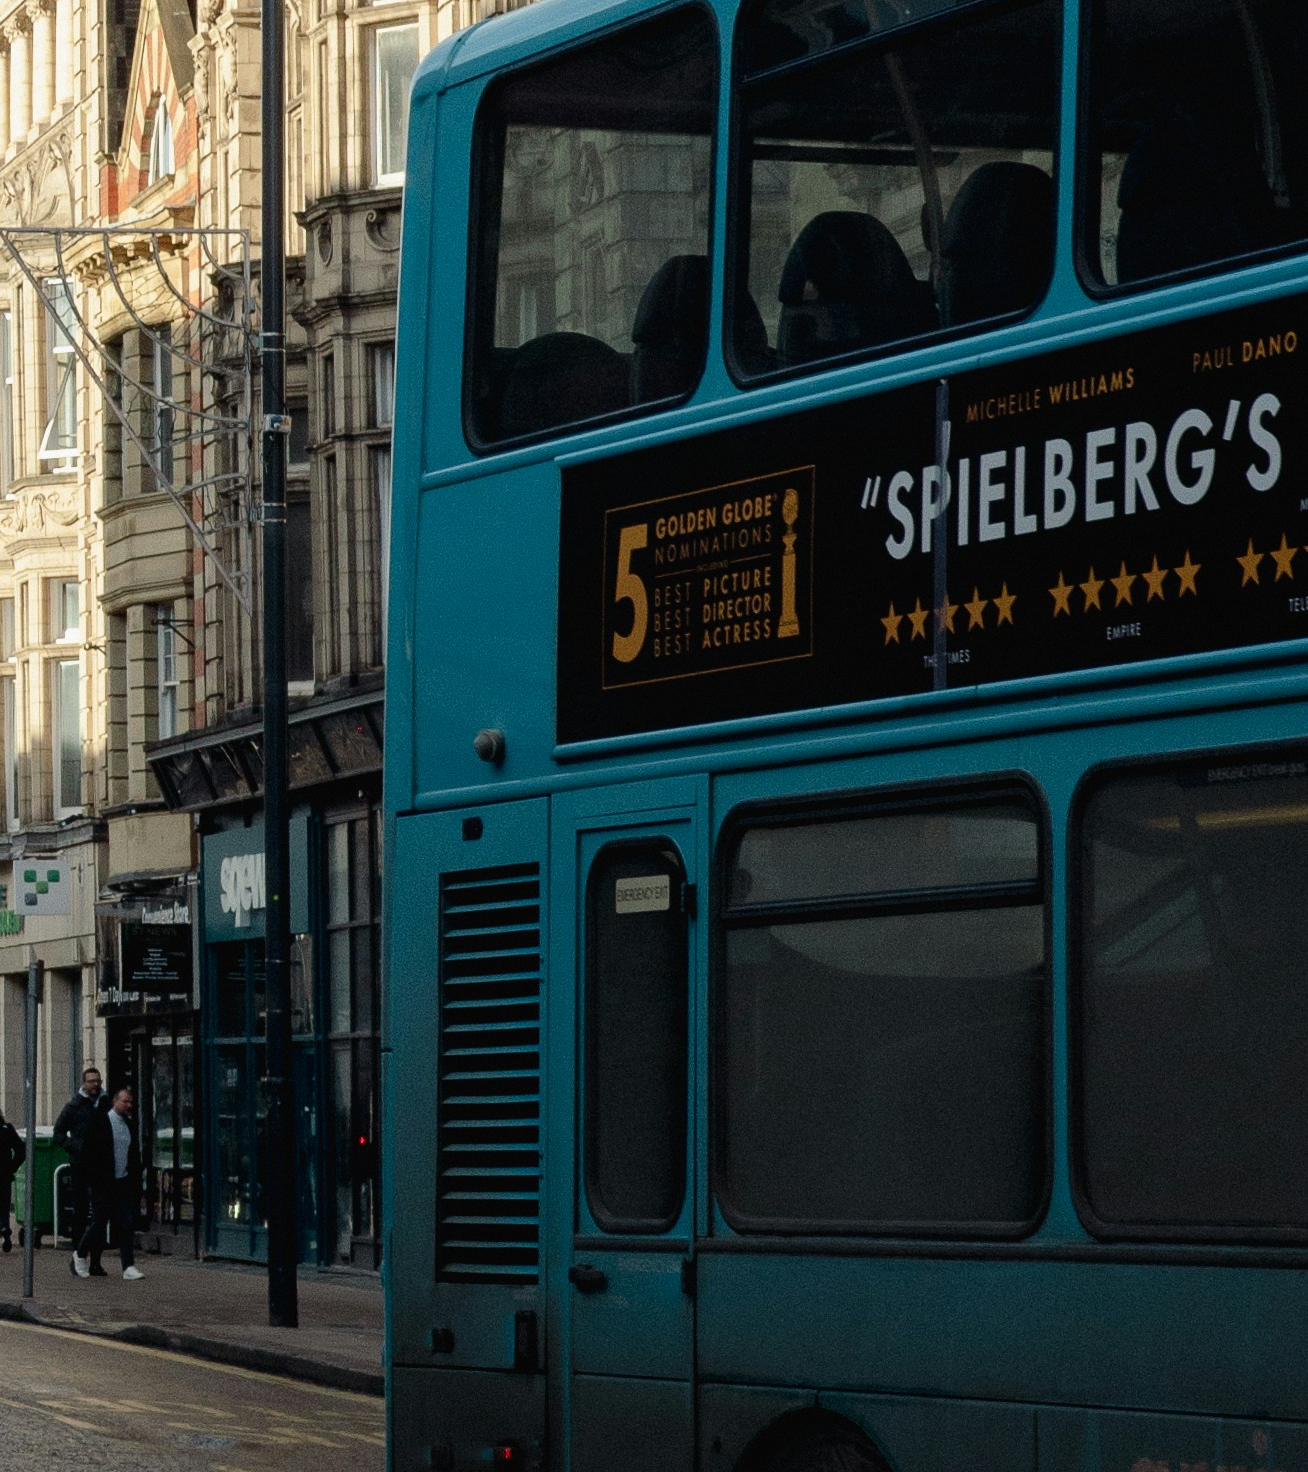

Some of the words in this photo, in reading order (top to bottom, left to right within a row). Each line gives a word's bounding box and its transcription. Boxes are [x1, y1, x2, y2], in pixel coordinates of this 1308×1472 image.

[1192, 347, 1235, 375] PAUL
[1241, 331, 1298, 364] DANO
[965, 388, 1042, 424] MICHELLE
[1048, 368, 1135, 406] WILLIAMS
[655, 506, 717, 540] GOLDEN
[655, 523, 773, 565] NOMINATIONS
[612, 523, 648, 663] 5
[654, 582, 691, 608] BEST
[703, 566, 772, 598] PICTURE
[654, 607, 691, 633] BEST
[703, 593, 772, 624] DIRECTOR
[1106, 623, 1141, 641] EMPIRE
[654, 632, 691, 658] BEST
[703, 618, 772, 650] ACTRESS
